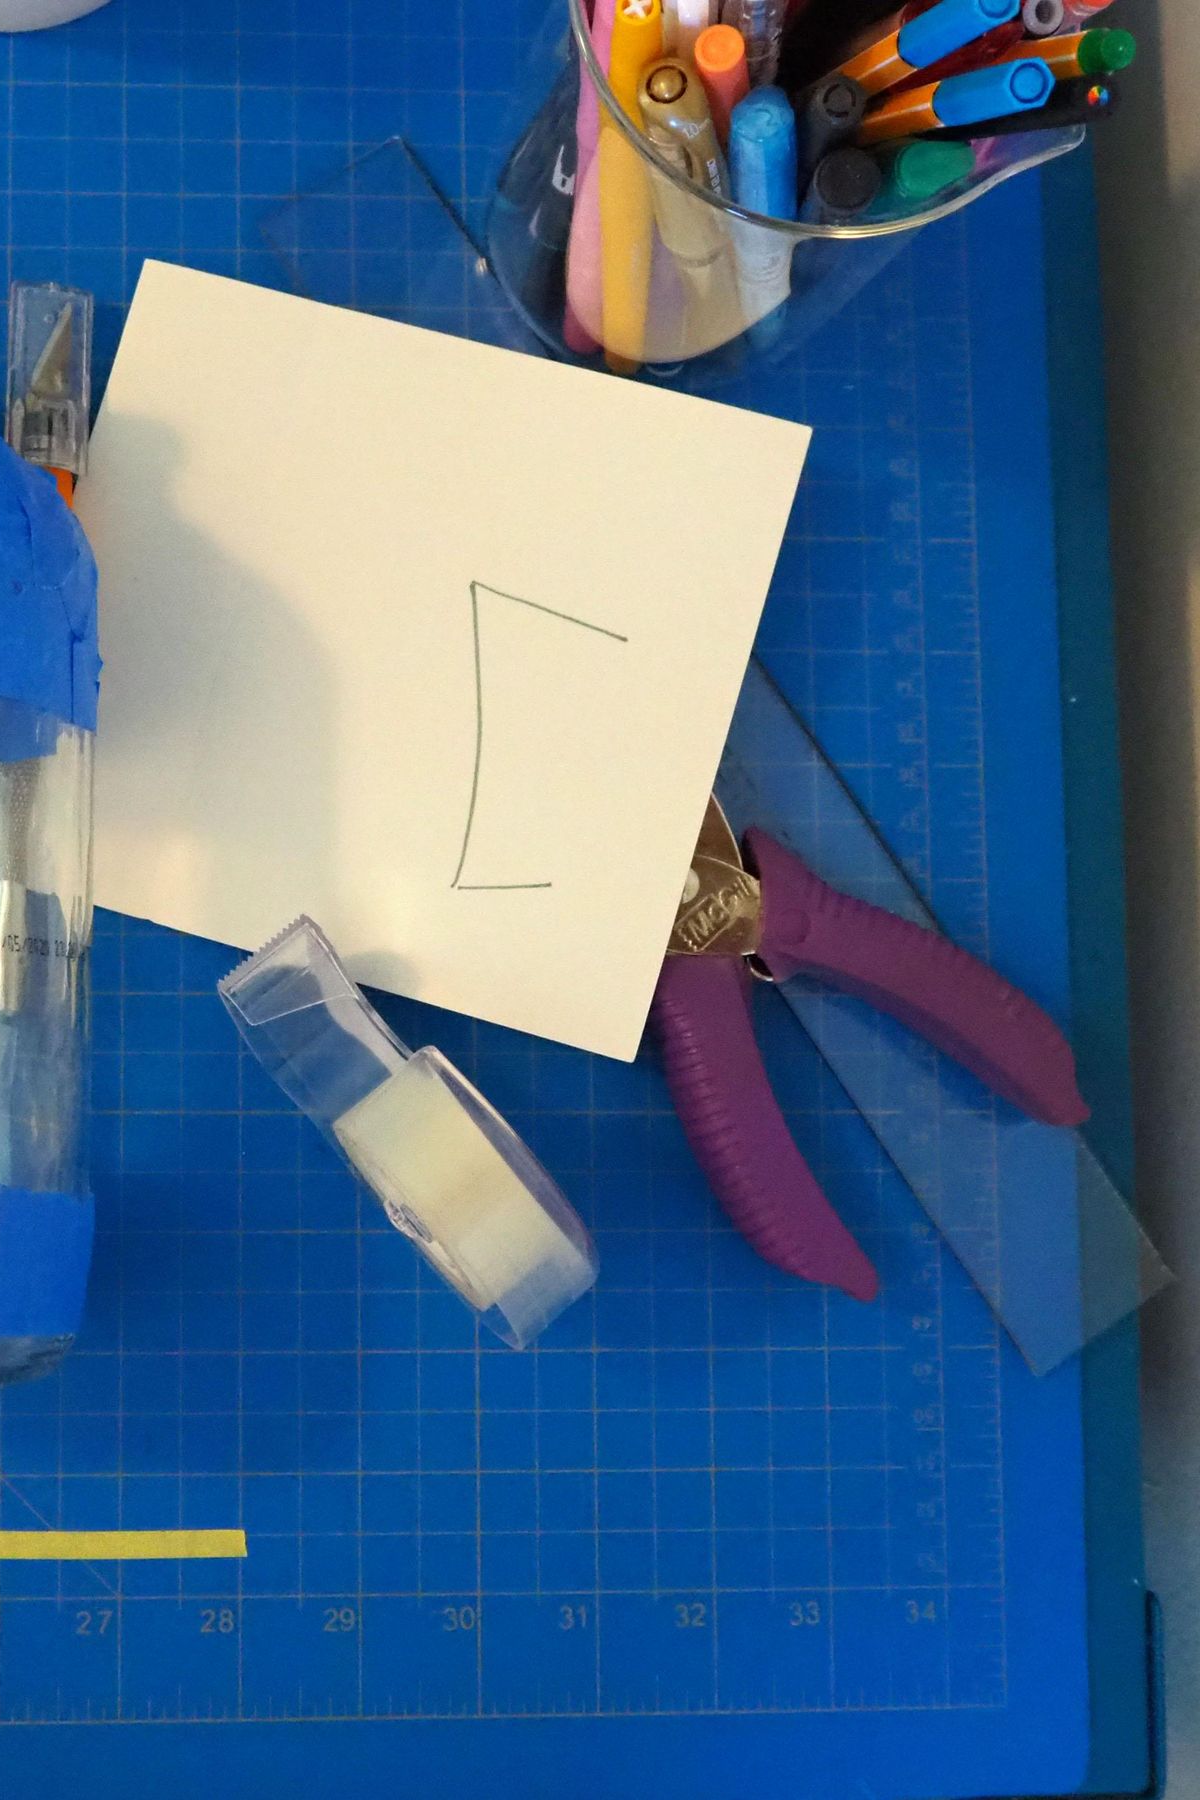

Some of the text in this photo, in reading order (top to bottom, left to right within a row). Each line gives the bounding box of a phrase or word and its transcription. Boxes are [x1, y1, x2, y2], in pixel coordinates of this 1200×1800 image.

[75, 1609, 114, 1636] 27
[200, 1608, 234, 1634] 28
[323, 1607, 356, 1633] 29
[443, 1606, 476, 1632] 30
[559, 1605, 588, 1631] 31
[674, 1602, 707, 1628] 32
[788, 1601, 821, 1627] 33
[905, 1600, 937, 1624] 34
